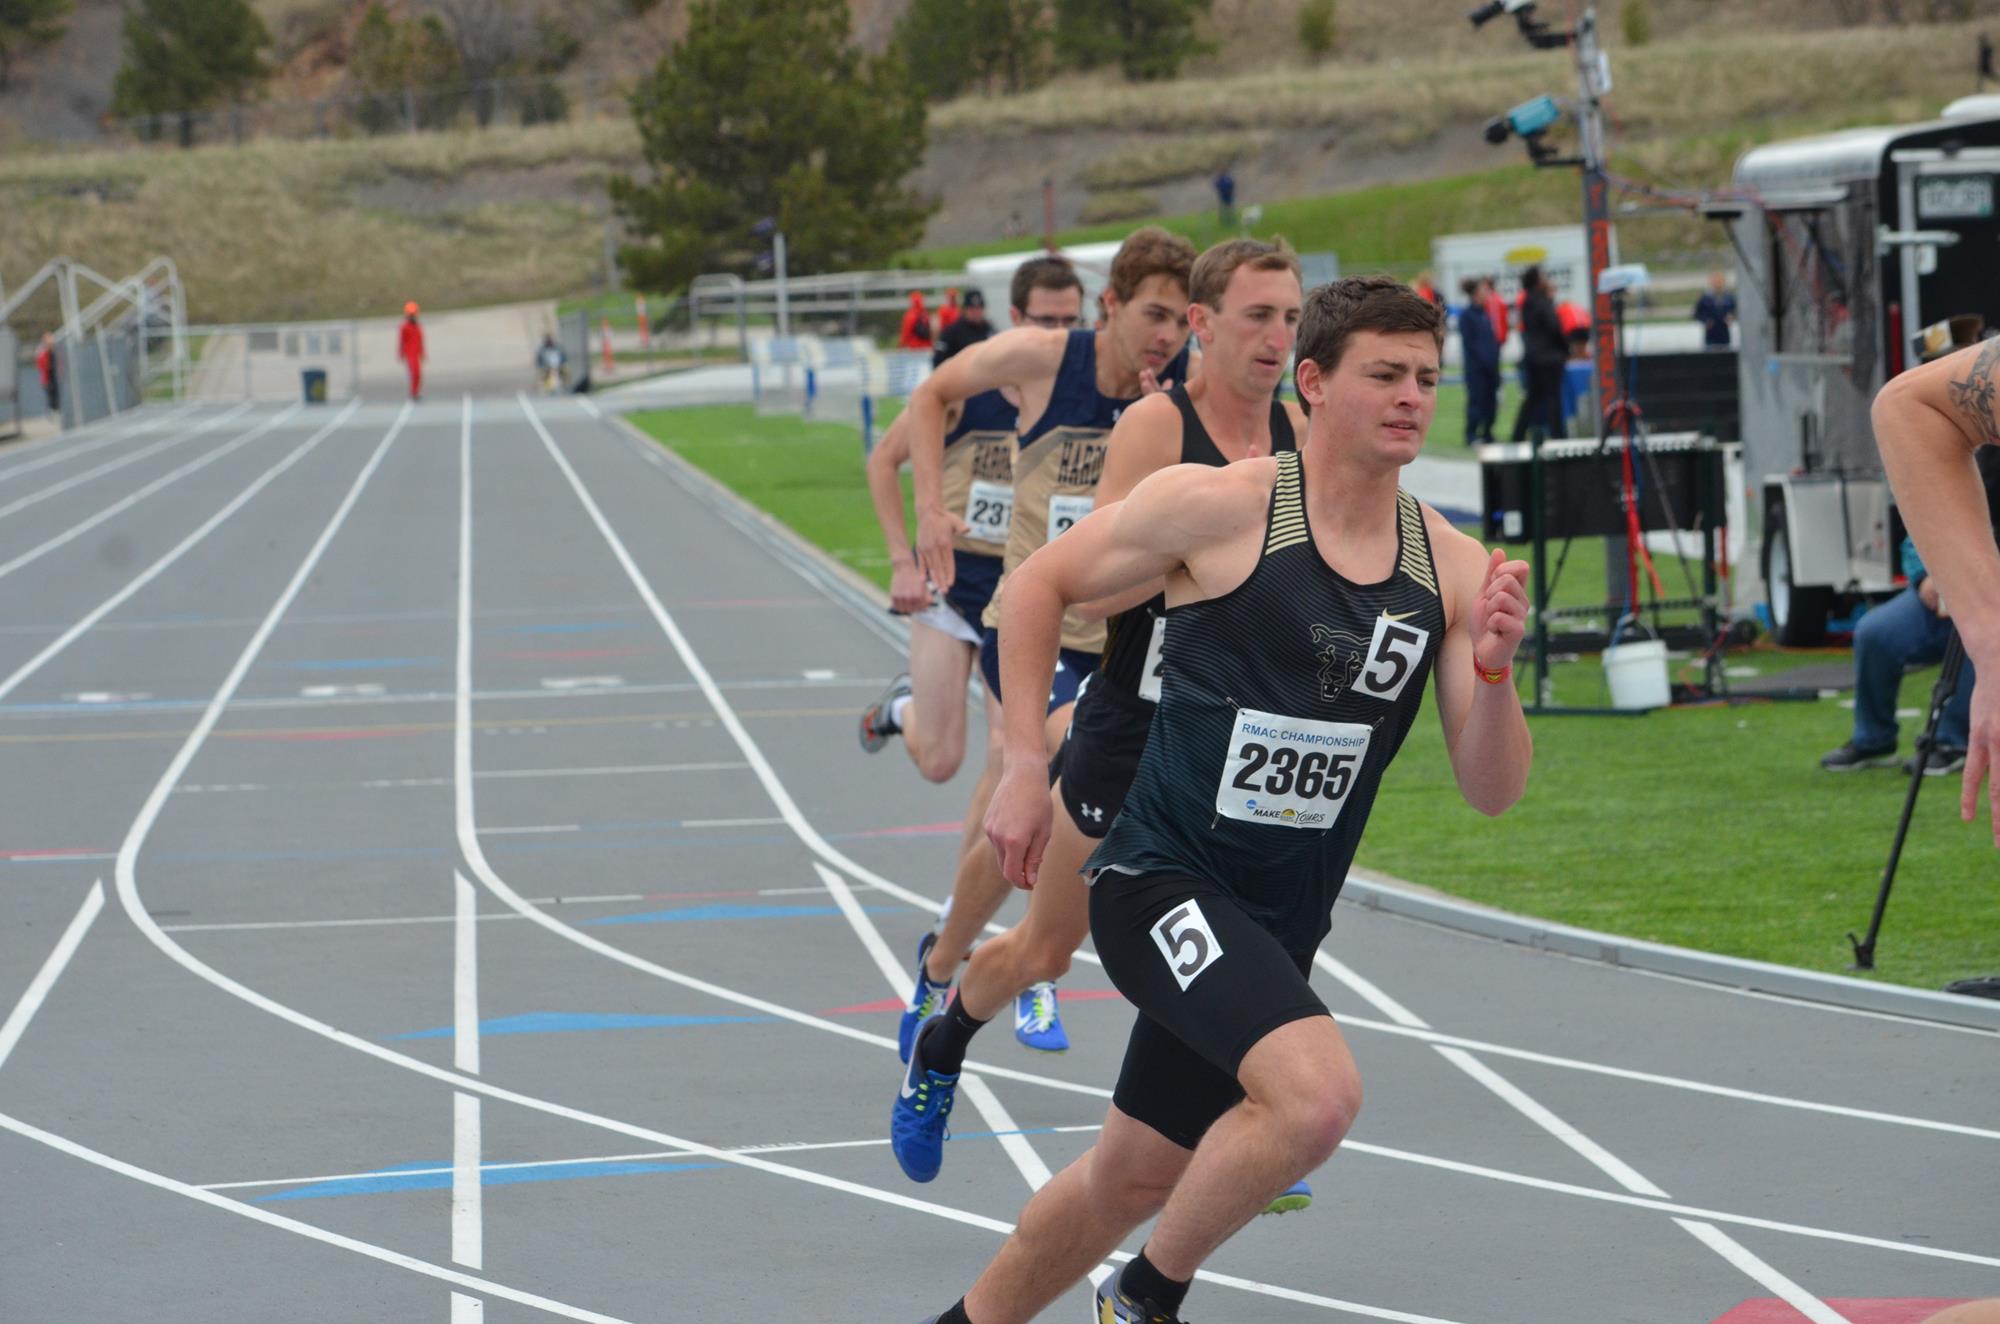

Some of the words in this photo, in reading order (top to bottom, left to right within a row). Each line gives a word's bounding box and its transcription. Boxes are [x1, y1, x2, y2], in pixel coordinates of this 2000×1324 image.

[1364, 624, 1420, 693] 5
[1241, 723, 1278, 738] RMAC
[1280, 730, 1366, 747] CHAMPIONSHIP
[1231, 742, 1357, 801] 2365
[1252, 808, 1281, 819] MAKE
[1158, 906, 1209, 977] 5
